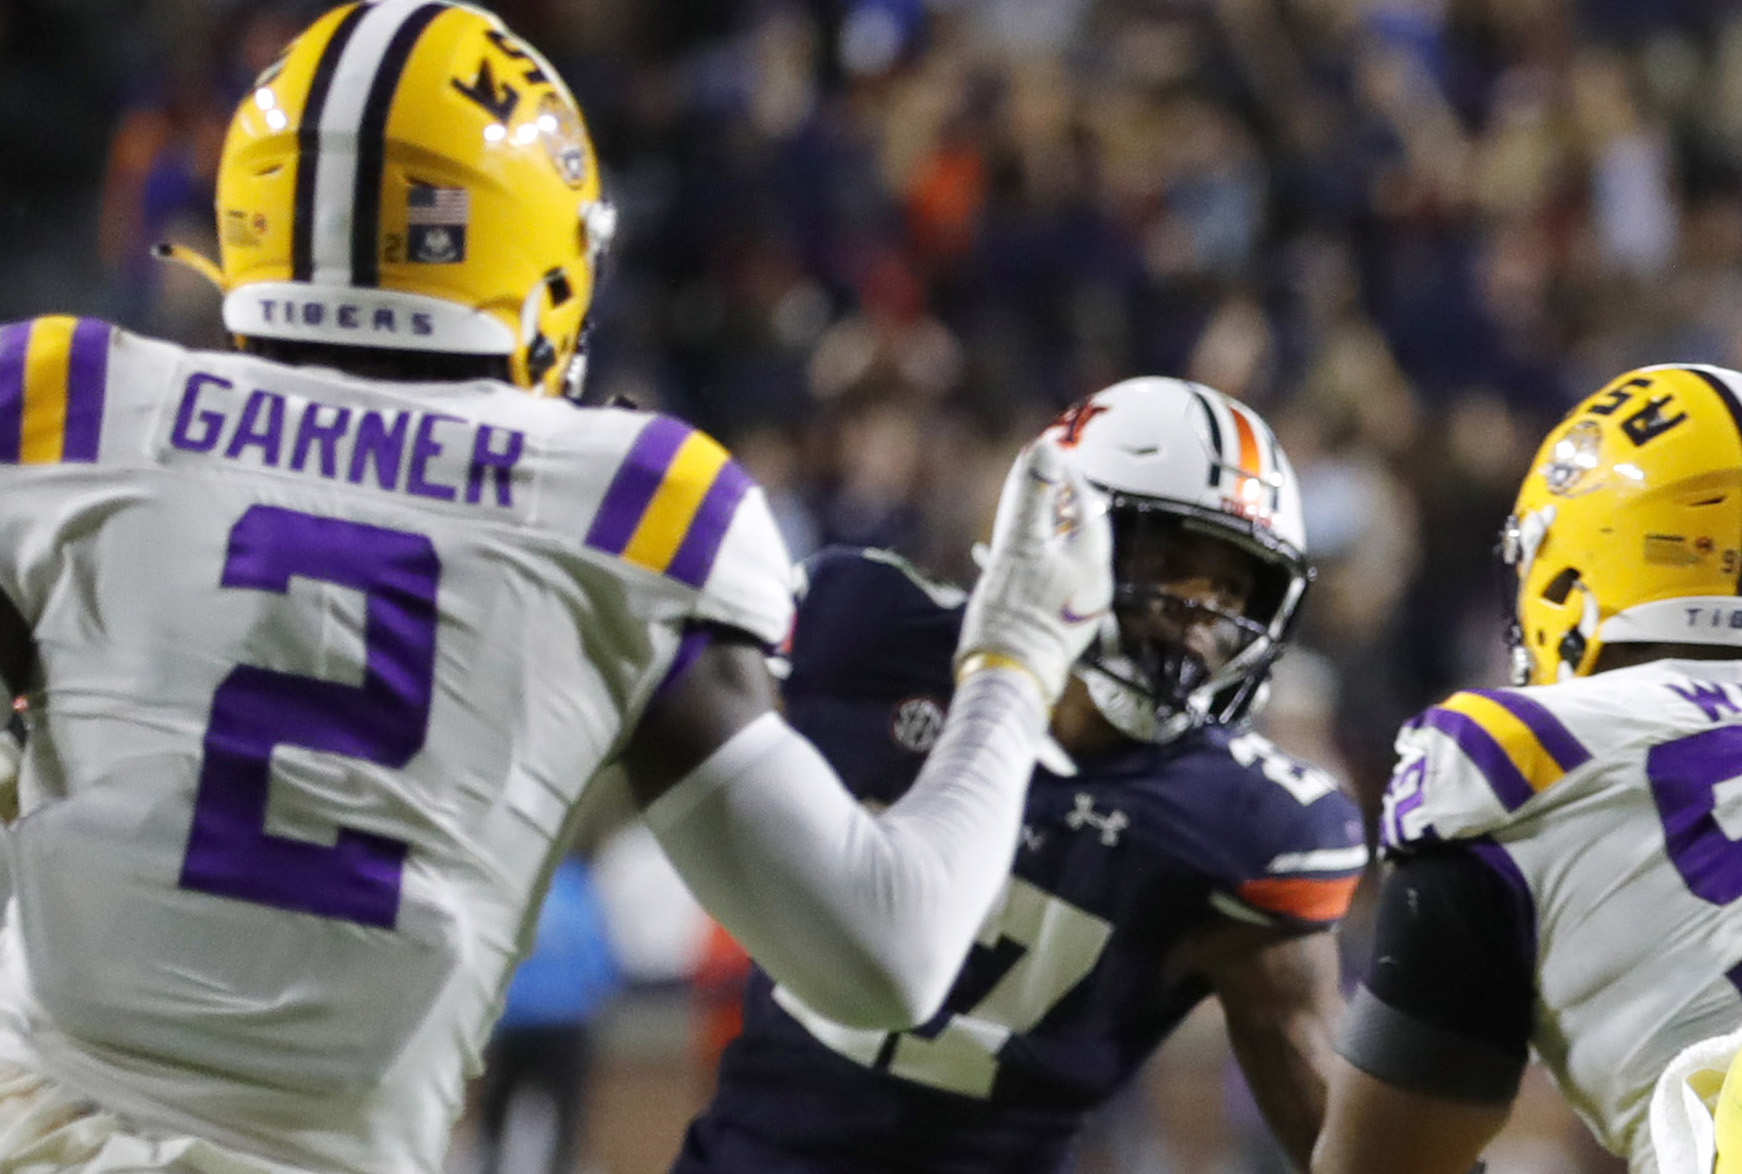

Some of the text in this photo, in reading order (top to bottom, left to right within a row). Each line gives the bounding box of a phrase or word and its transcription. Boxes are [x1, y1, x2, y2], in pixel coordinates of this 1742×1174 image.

[258, 299, 435, 336] TIGERS
[170, 371, 525, 507] GARNER
[179, 503, 443, 931] 2
